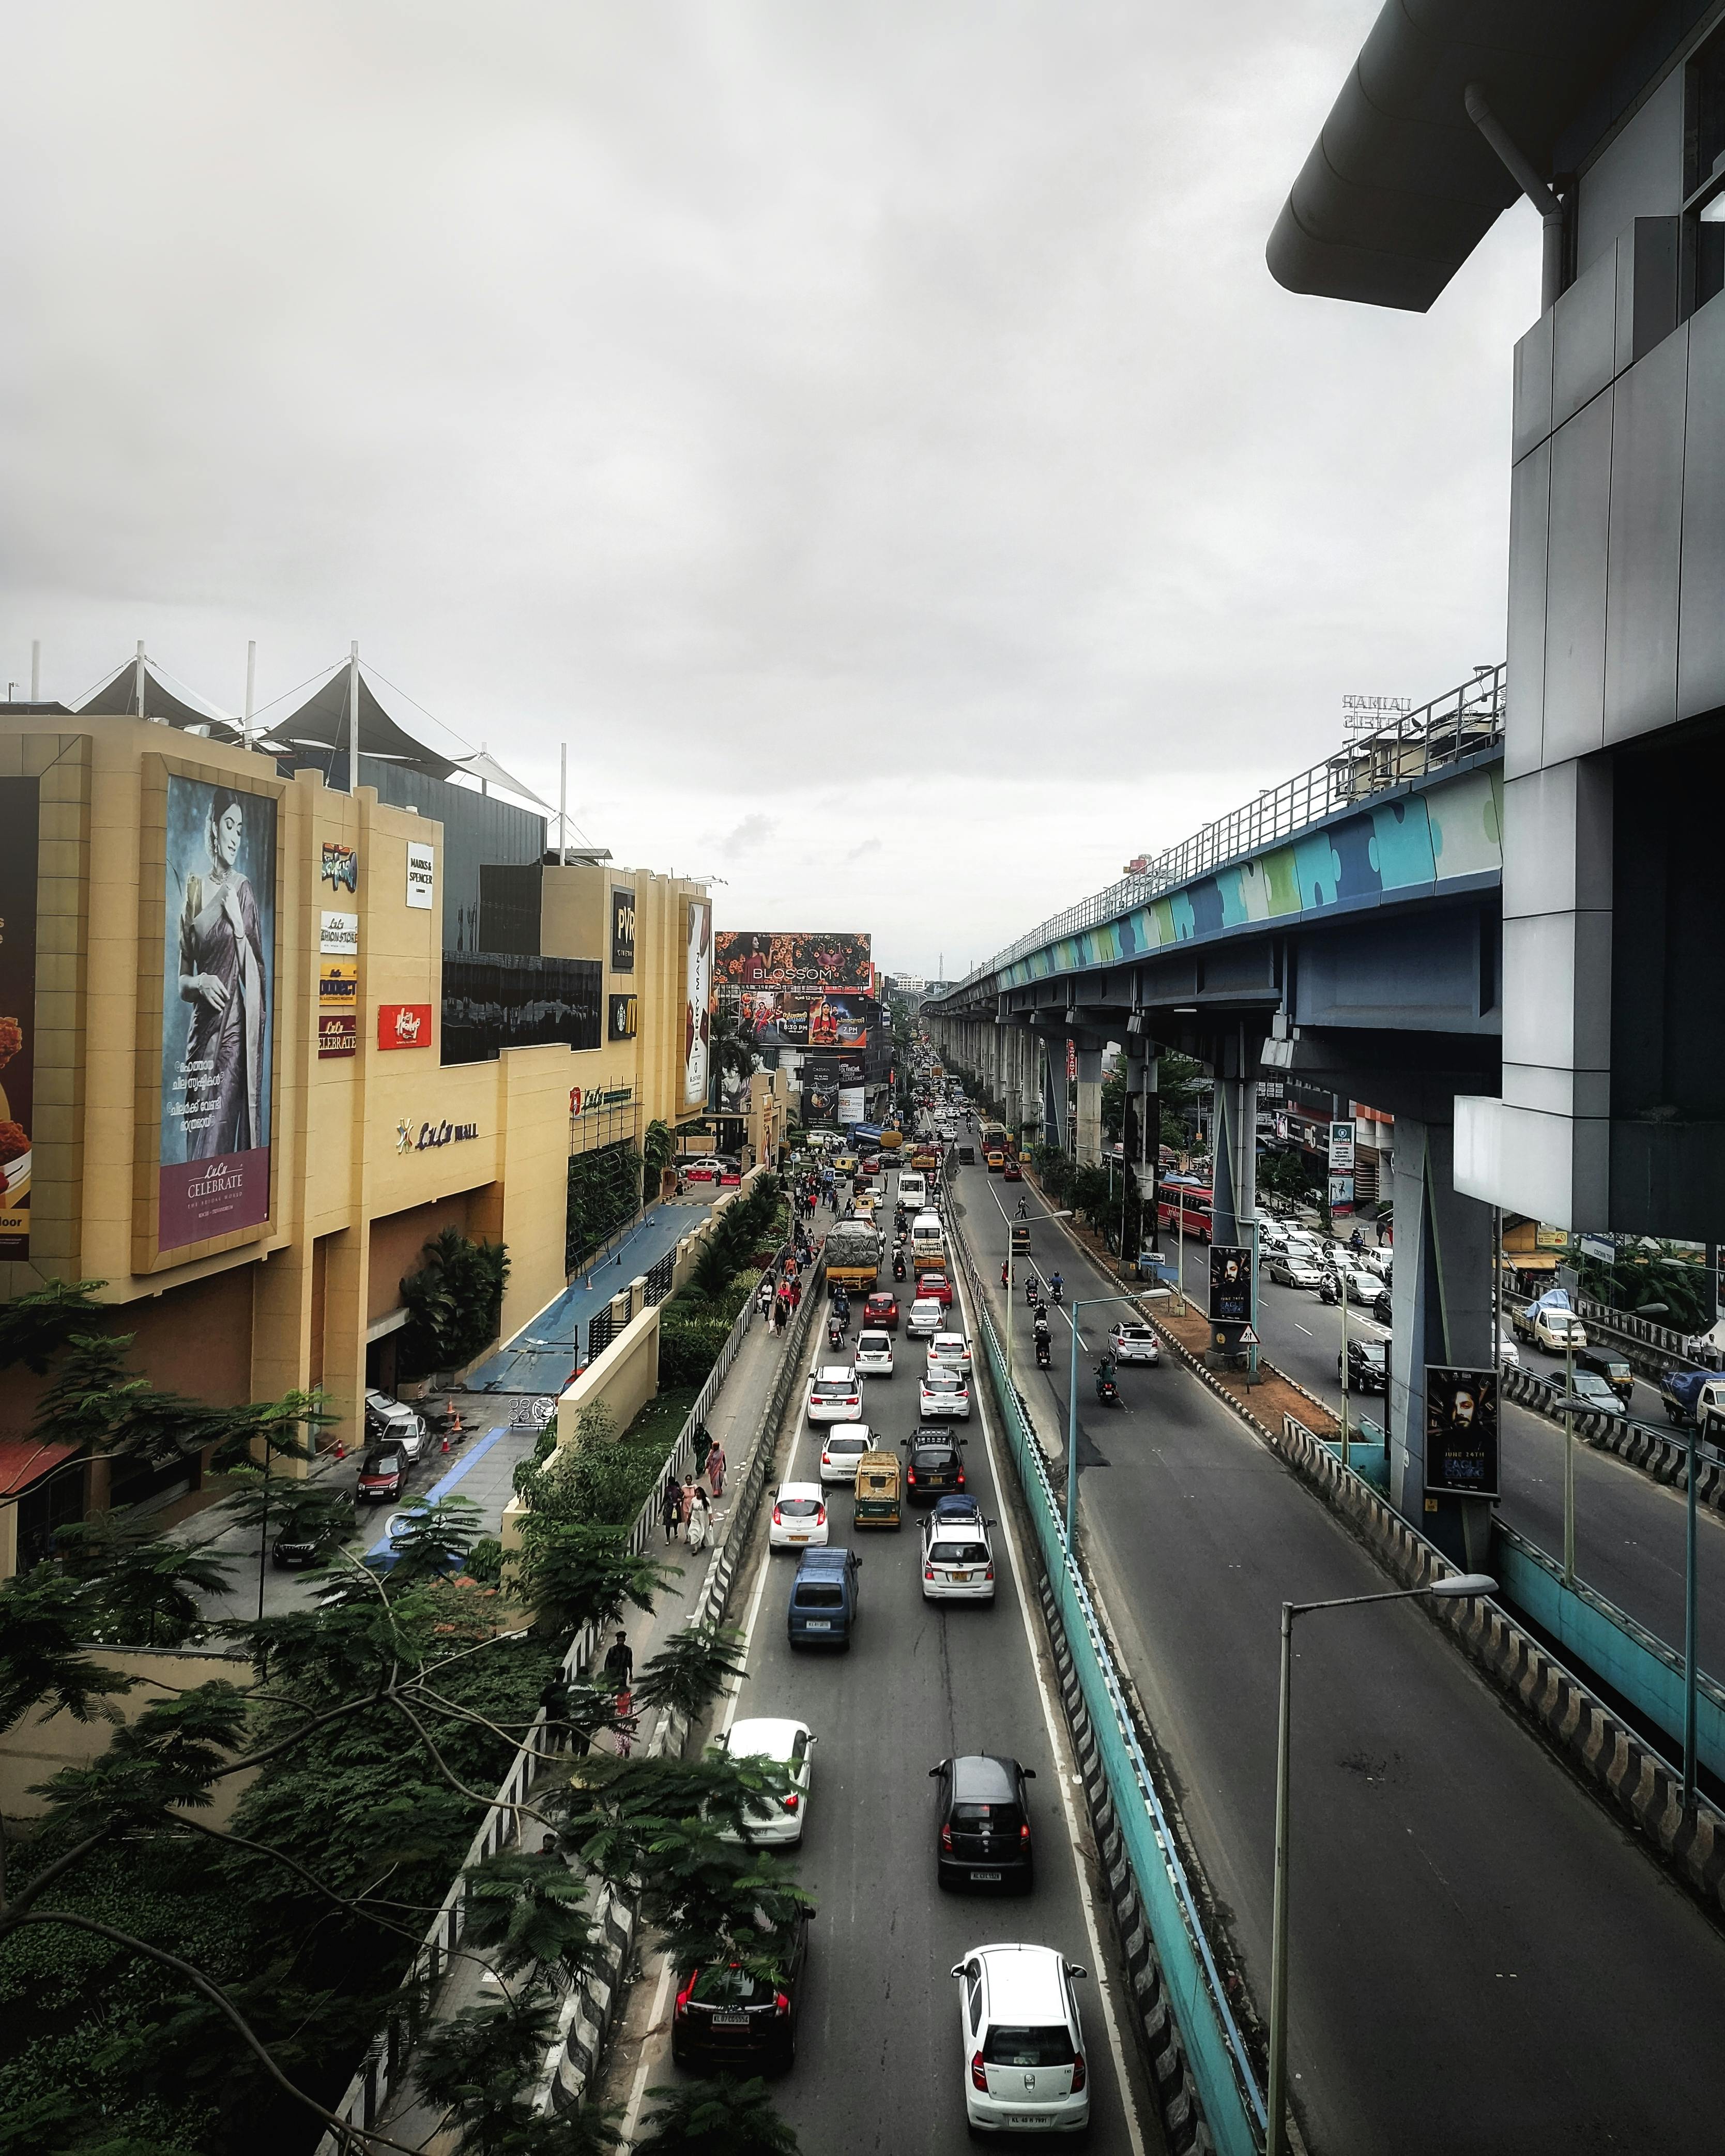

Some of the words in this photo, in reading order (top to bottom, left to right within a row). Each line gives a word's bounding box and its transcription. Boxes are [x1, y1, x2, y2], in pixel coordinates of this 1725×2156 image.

[410, 858, 428, 870] MARKS
[428, 862, 432, 871] &
[409, 872, 433, 884] SPENCER
[618, 906, 635, 944] PVR
[753, 968, 832, 980] BLOSSOM
[325, 1021, 344, 1035] LuLu
[318, 1036, 356, 1050] ELEBRATE
[172, 1076, 187, 1090] ചില
[415, 1119, 453, 1151] LuLu
[205, 1162, 228, 1179] LuLu
[188, 1174, 243, 1198] CELEBRATE
[0, 1216, 22, 1227] loor
[1594, 1248, 1606, 1259] COCHIN
[1445, 1459, 1485, 1469] EAGLE
